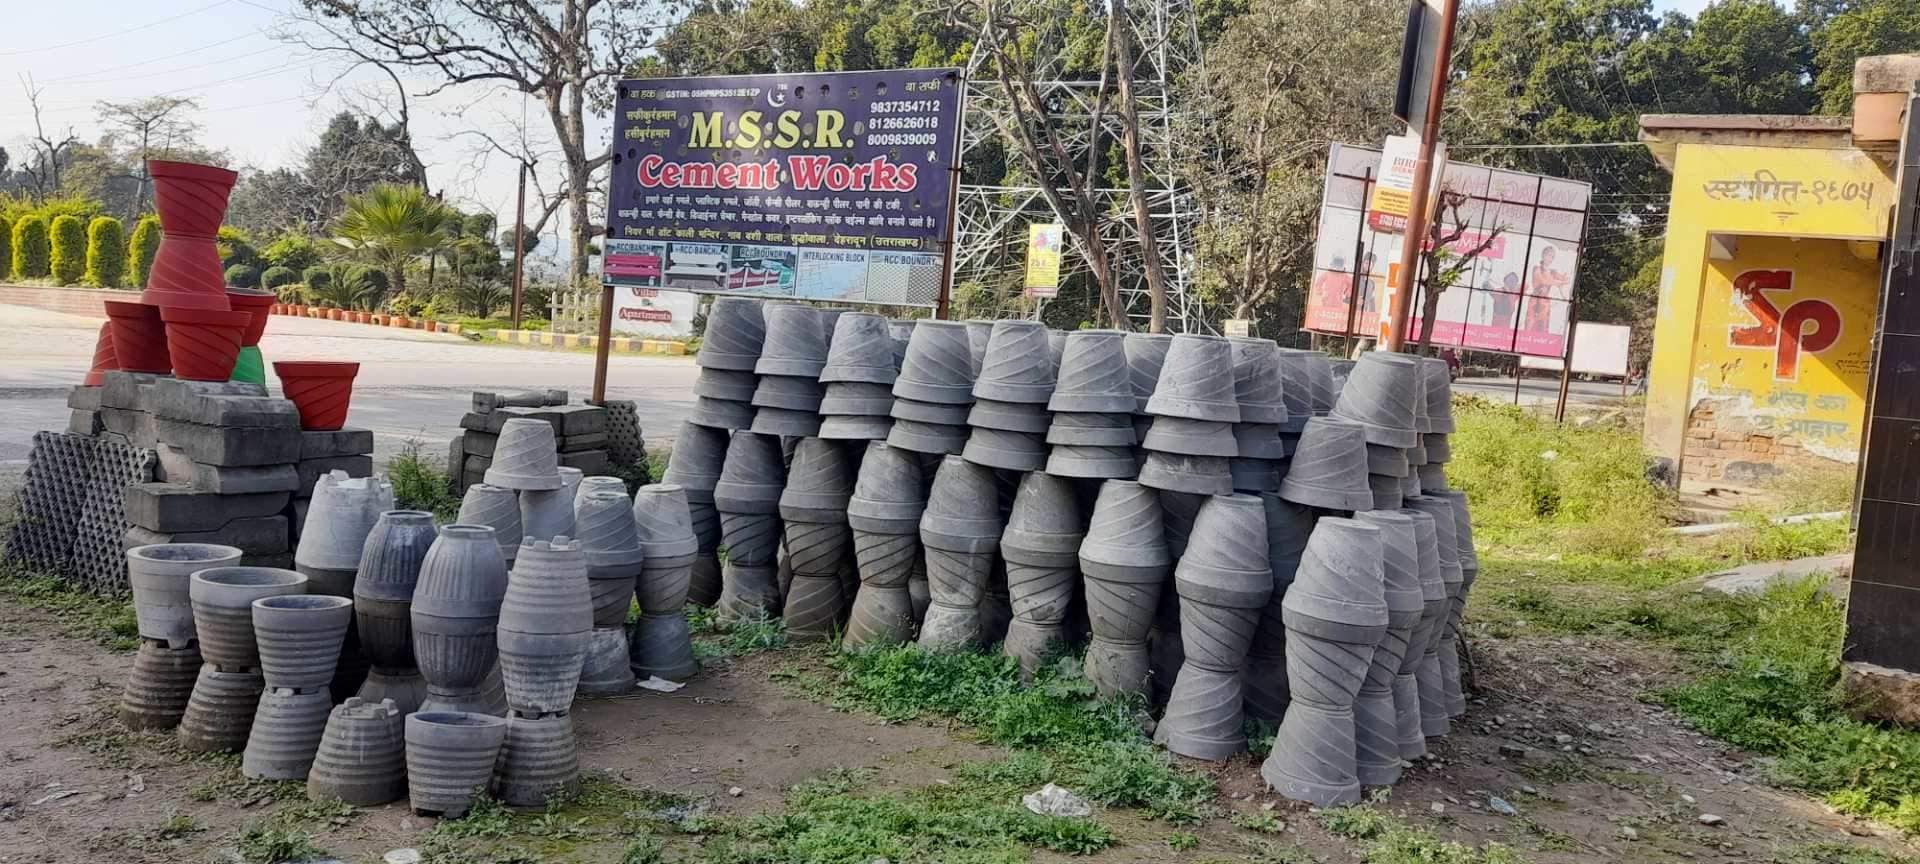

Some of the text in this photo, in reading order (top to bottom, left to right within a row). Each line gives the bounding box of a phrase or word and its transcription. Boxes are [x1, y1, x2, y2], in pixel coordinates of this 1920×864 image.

[919, 78, 941, 91] सफी
[870, 100, 940, 113] 9837354712
[687, 109, 855, 149] M.S.S.R.
[869, 117, 938, 129] 8126626018
[867, 133, 937, 146] 8009839009
[637, 153, 918, 192] Cement Works
[855, 197, 871, 210] पानी
[873, 197, 883, 210] की
[675, 226, 695, 238] काली
[832, 232, 866, 248] देहरादून
[803, 251, 865, 263] INTERLOCKING BLOCK
[884, 255, 936, 265] RCC BOUNDRY
[619, 307, 672, 323] Apartments
